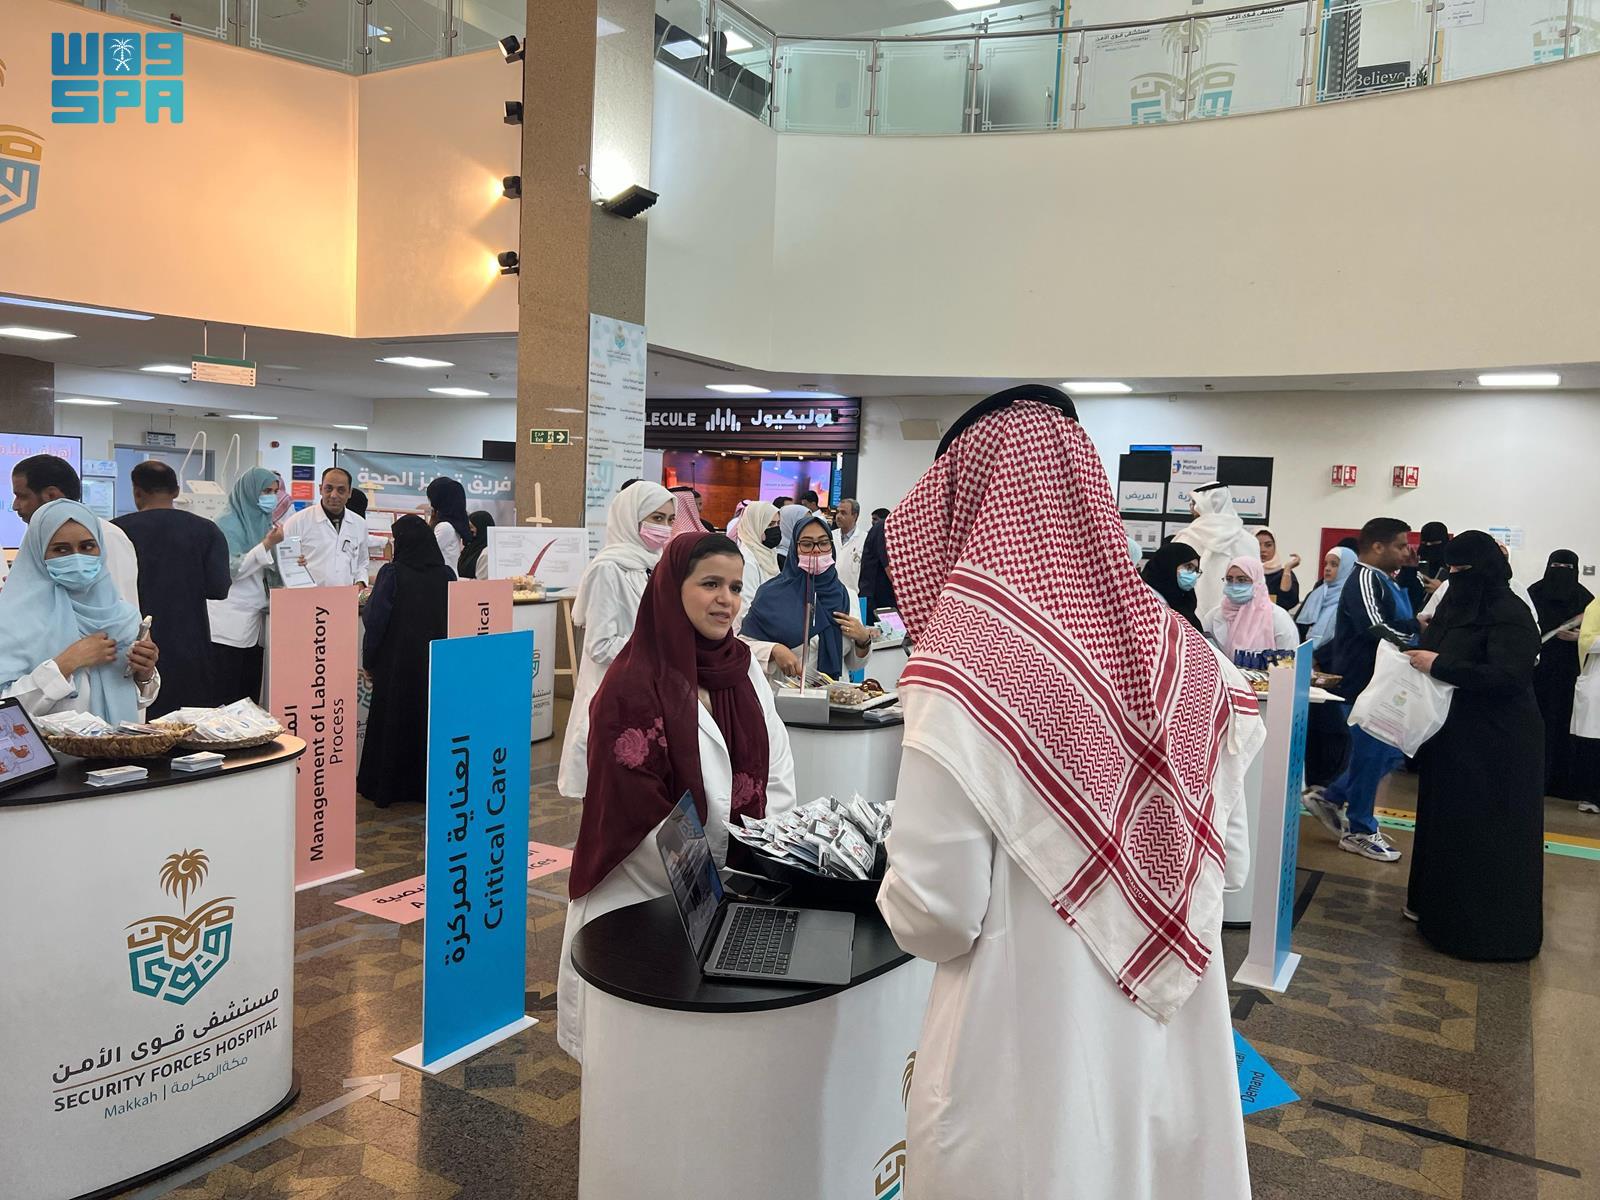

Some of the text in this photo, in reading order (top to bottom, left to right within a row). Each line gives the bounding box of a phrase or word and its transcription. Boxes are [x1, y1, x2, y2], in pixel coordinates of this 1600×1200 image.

[1356, 71, 1405, 87] Believe
[357, 467, 413, 487] الصحة
[467, 475, 512, 496] فريق
[1125, 492, 1158, 501] المريض
[310, 606, 330, 862] Management of Laboratory
[329, 698, 344, 765] Process
[445, 735, 474, 966] العناية المركزة
[484, 747, 507, 930] Critical Care
[52, 988, 279, 1084] مستشفى قوى الأمن
[54, 1017, 278, 1112] SECURITY FORCES HOSPITAL
[1240, 1070, 1265, 1103] Demand
[104, 1090, 158, 1119] Makkah
